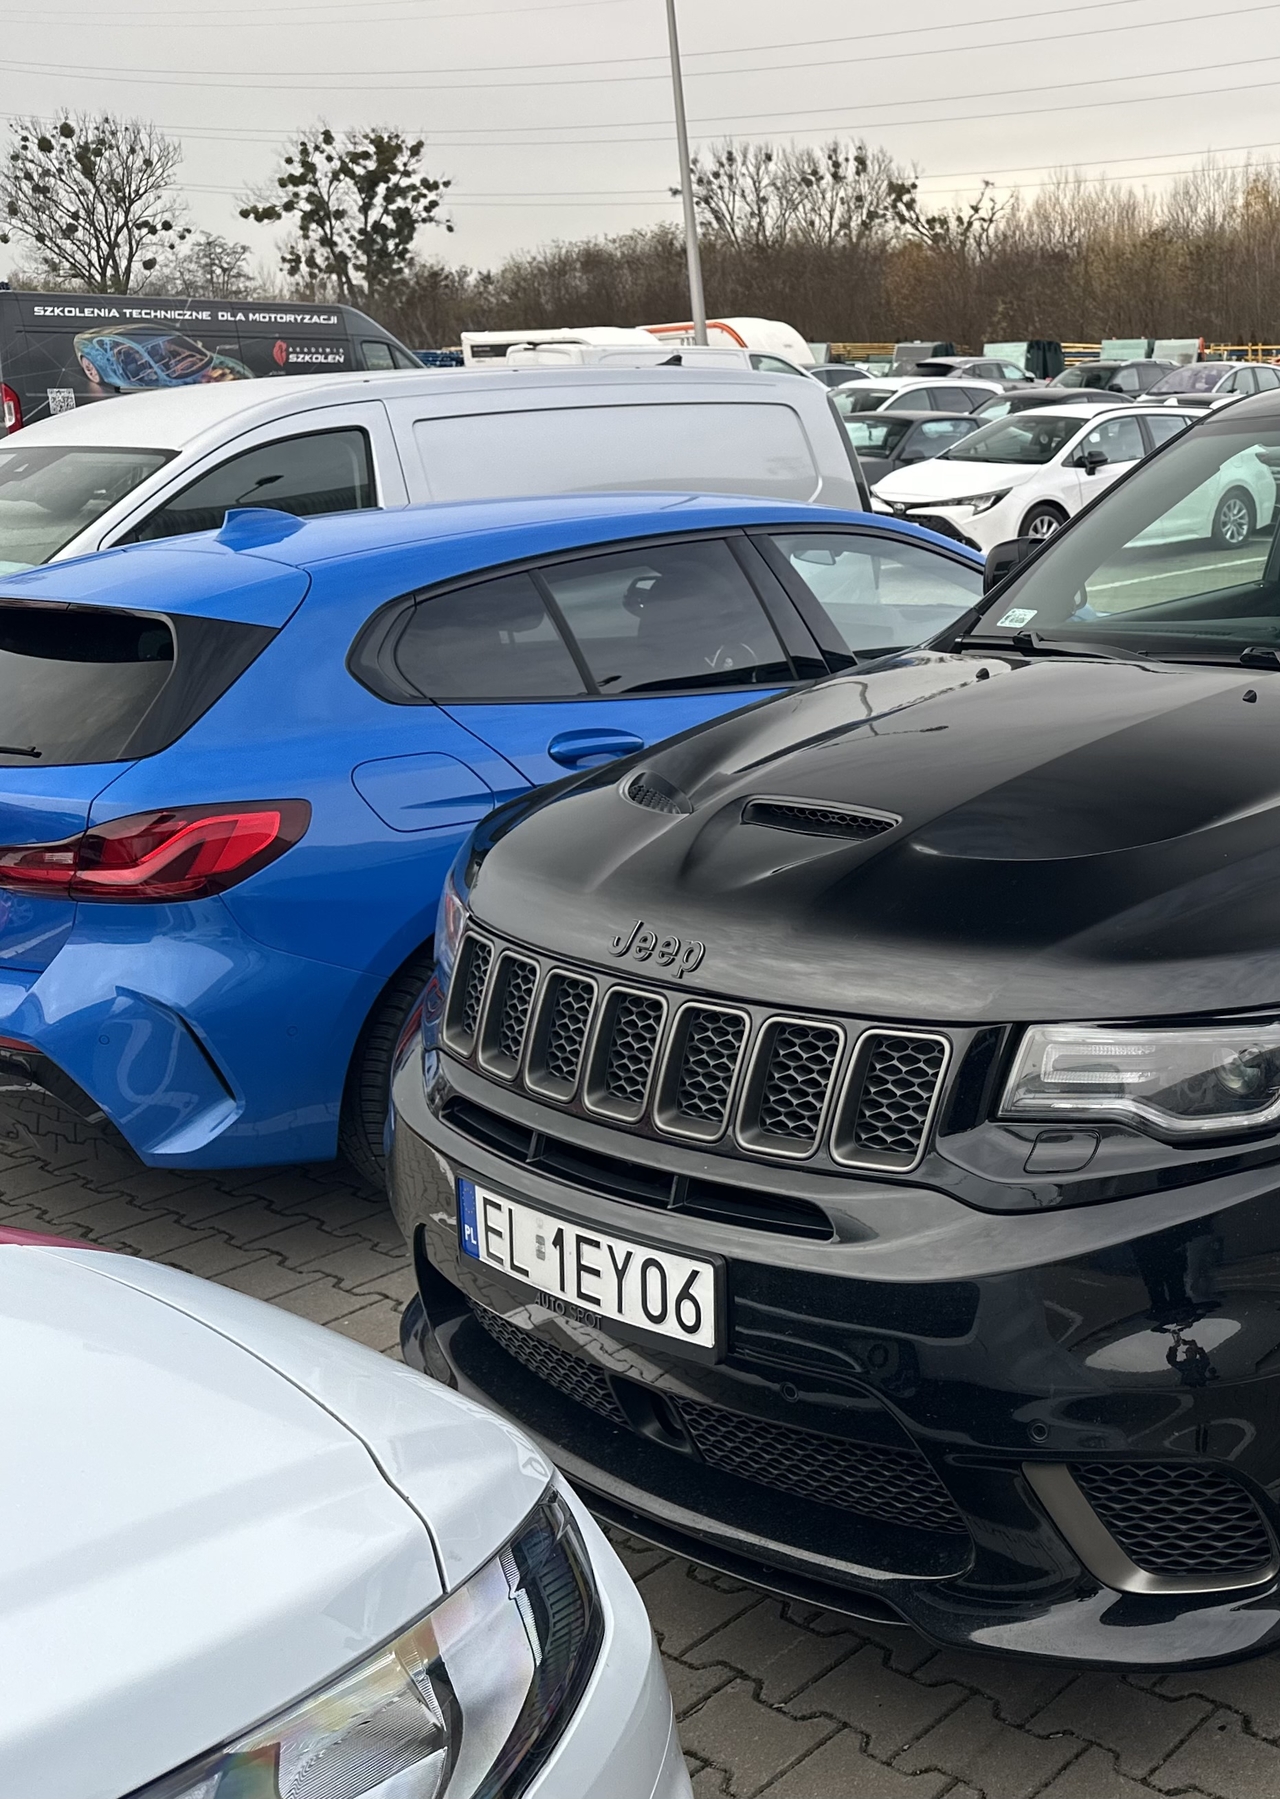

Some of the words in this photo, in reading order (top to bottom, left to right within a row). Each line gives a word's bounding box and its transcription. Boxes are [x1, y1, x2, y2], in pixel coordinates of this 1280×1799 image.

[33, 306, 120, 318] SZKOLENIA
[123, 308, 212, 320] TECHNICZNE
[217, 311, 246, 322] DLA
[248, 312, 338, 325] MOTORYZACJI
[288, 352, 345, 364] SZKOLEŃ
[608, 918, 706, 979] Jeep
[464, 1224, 477, 1245] PL
[482, 1196, 530, 1278] EL
[551, 1226, 703, 1335] 1EY06
[534, 1291, 565, 1316] AUTO
[569, 1305, 602, 1330] SPOT
